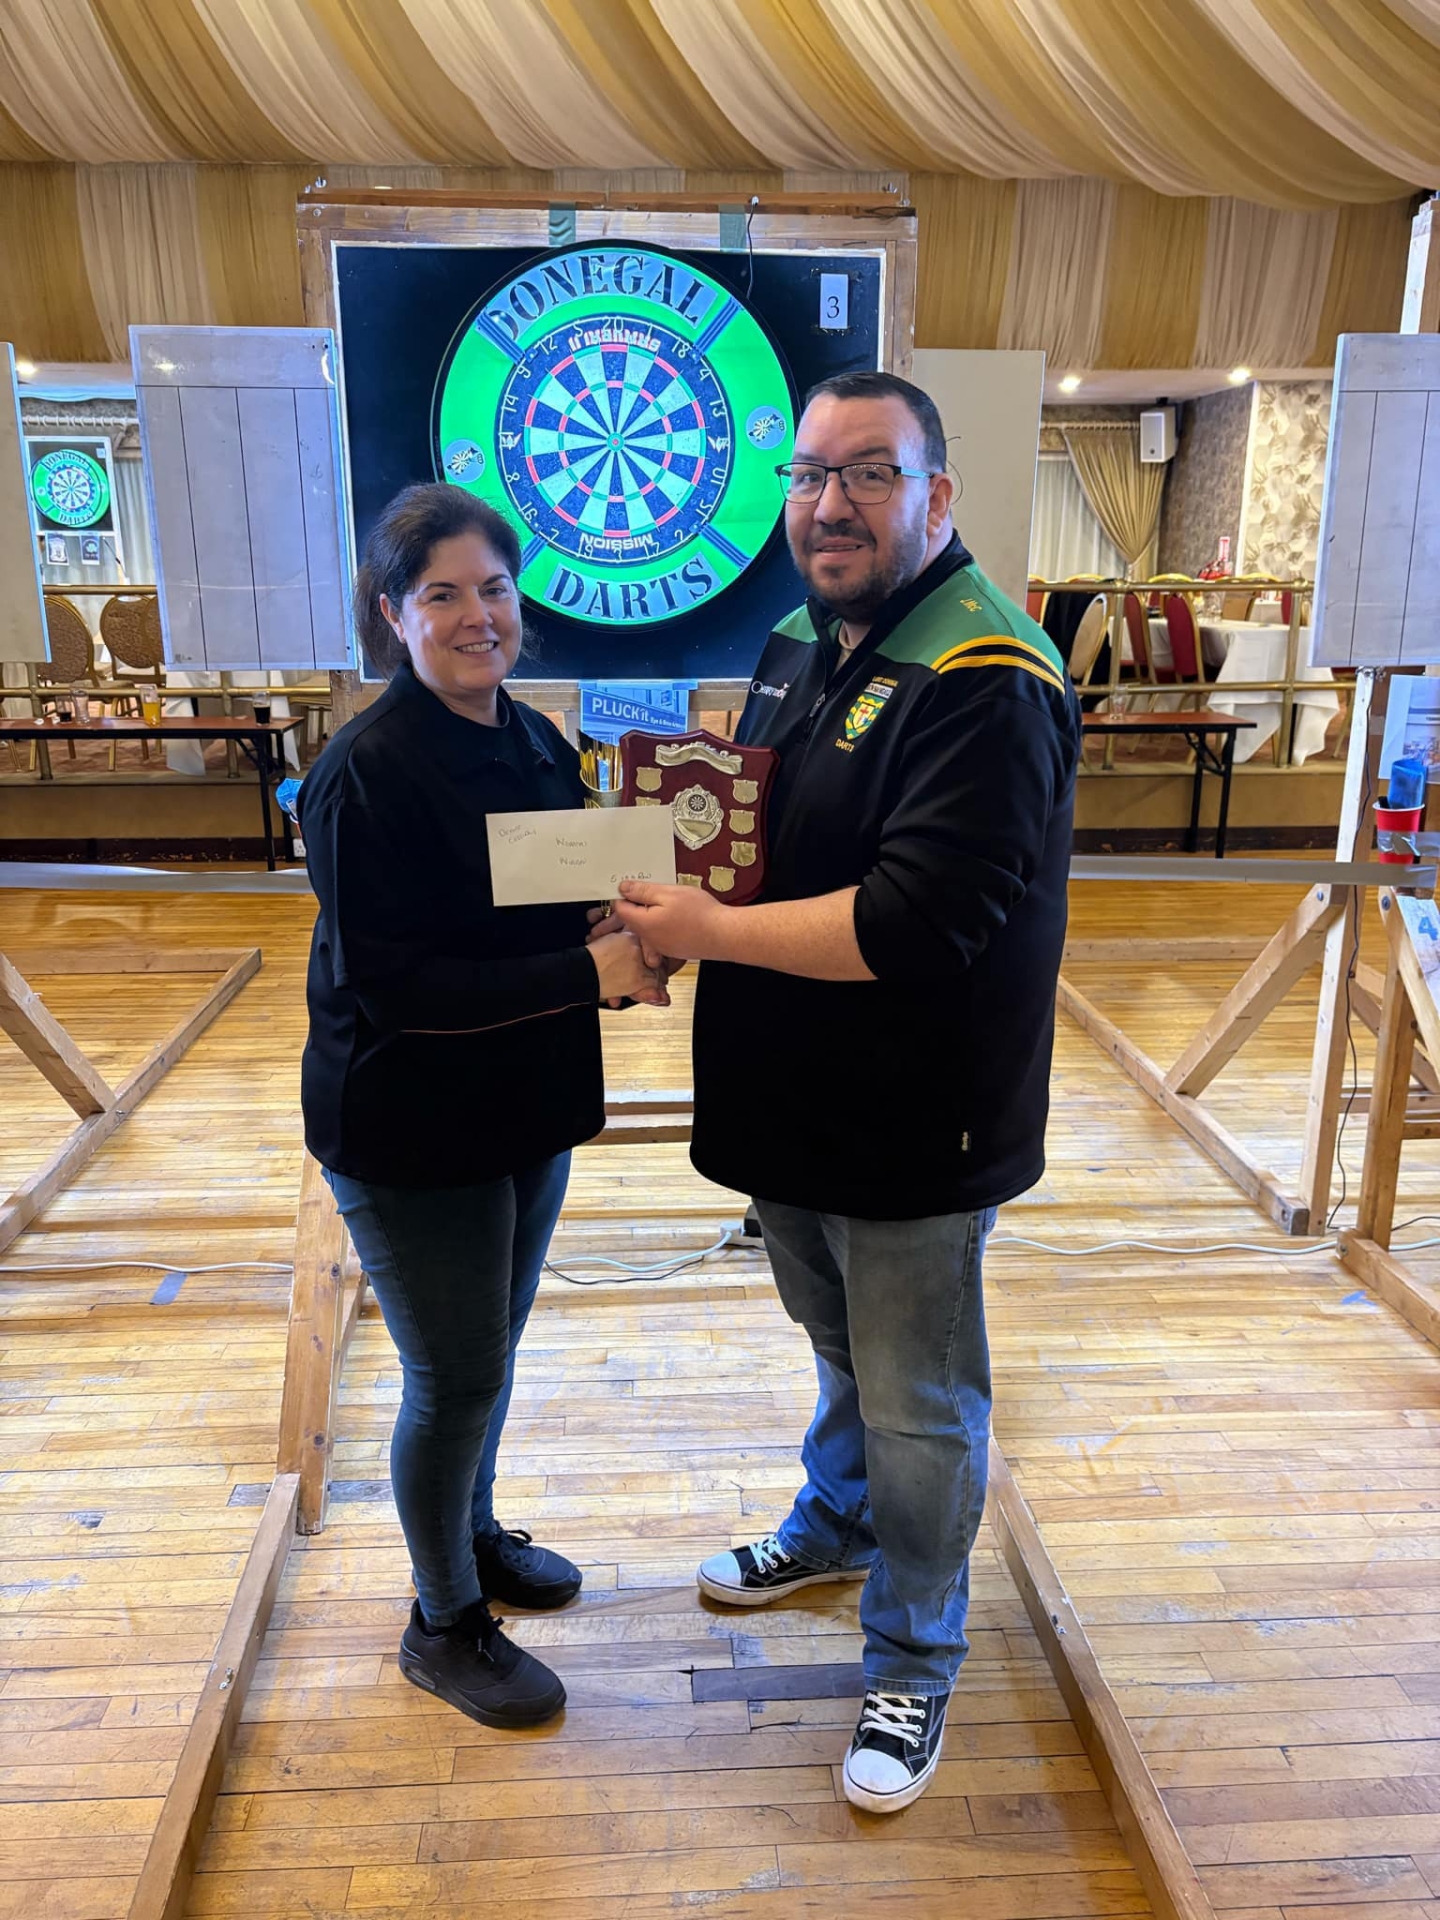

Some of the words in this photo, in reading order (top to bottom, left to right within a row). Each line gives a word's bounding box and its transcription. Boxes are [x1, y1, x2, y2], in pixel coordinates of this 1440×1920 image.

[487, 254, 706, 341] DONEGAL
[827, 295, 840, 319] 3
[572, 319, 583, 338] 5
[601, 315, 624, 333] 20
[535, 335, 558, 355] 12
[671, 337, 692, 359] 18
[699, 368, 712, 381] 4
[501, 394, 519, 413] 14
[709, 400, 728, 418] 13
[505, 472, 521, 483] 8
[710, 467, 728, 486] 10
[520, 501, 539, 524] 16
[695, 499, 715, 520] 15
[550, 528, 560, 541] 7
[579, 532, 654, 551] MISSION
[674, 529, 685, 541] 2
[643, 541, 660, 559] 17
[550, 556, 713, 619] DARTS
[835, 738, 856, 753] DARTS
[1418, 916, 1439, 941] 4
